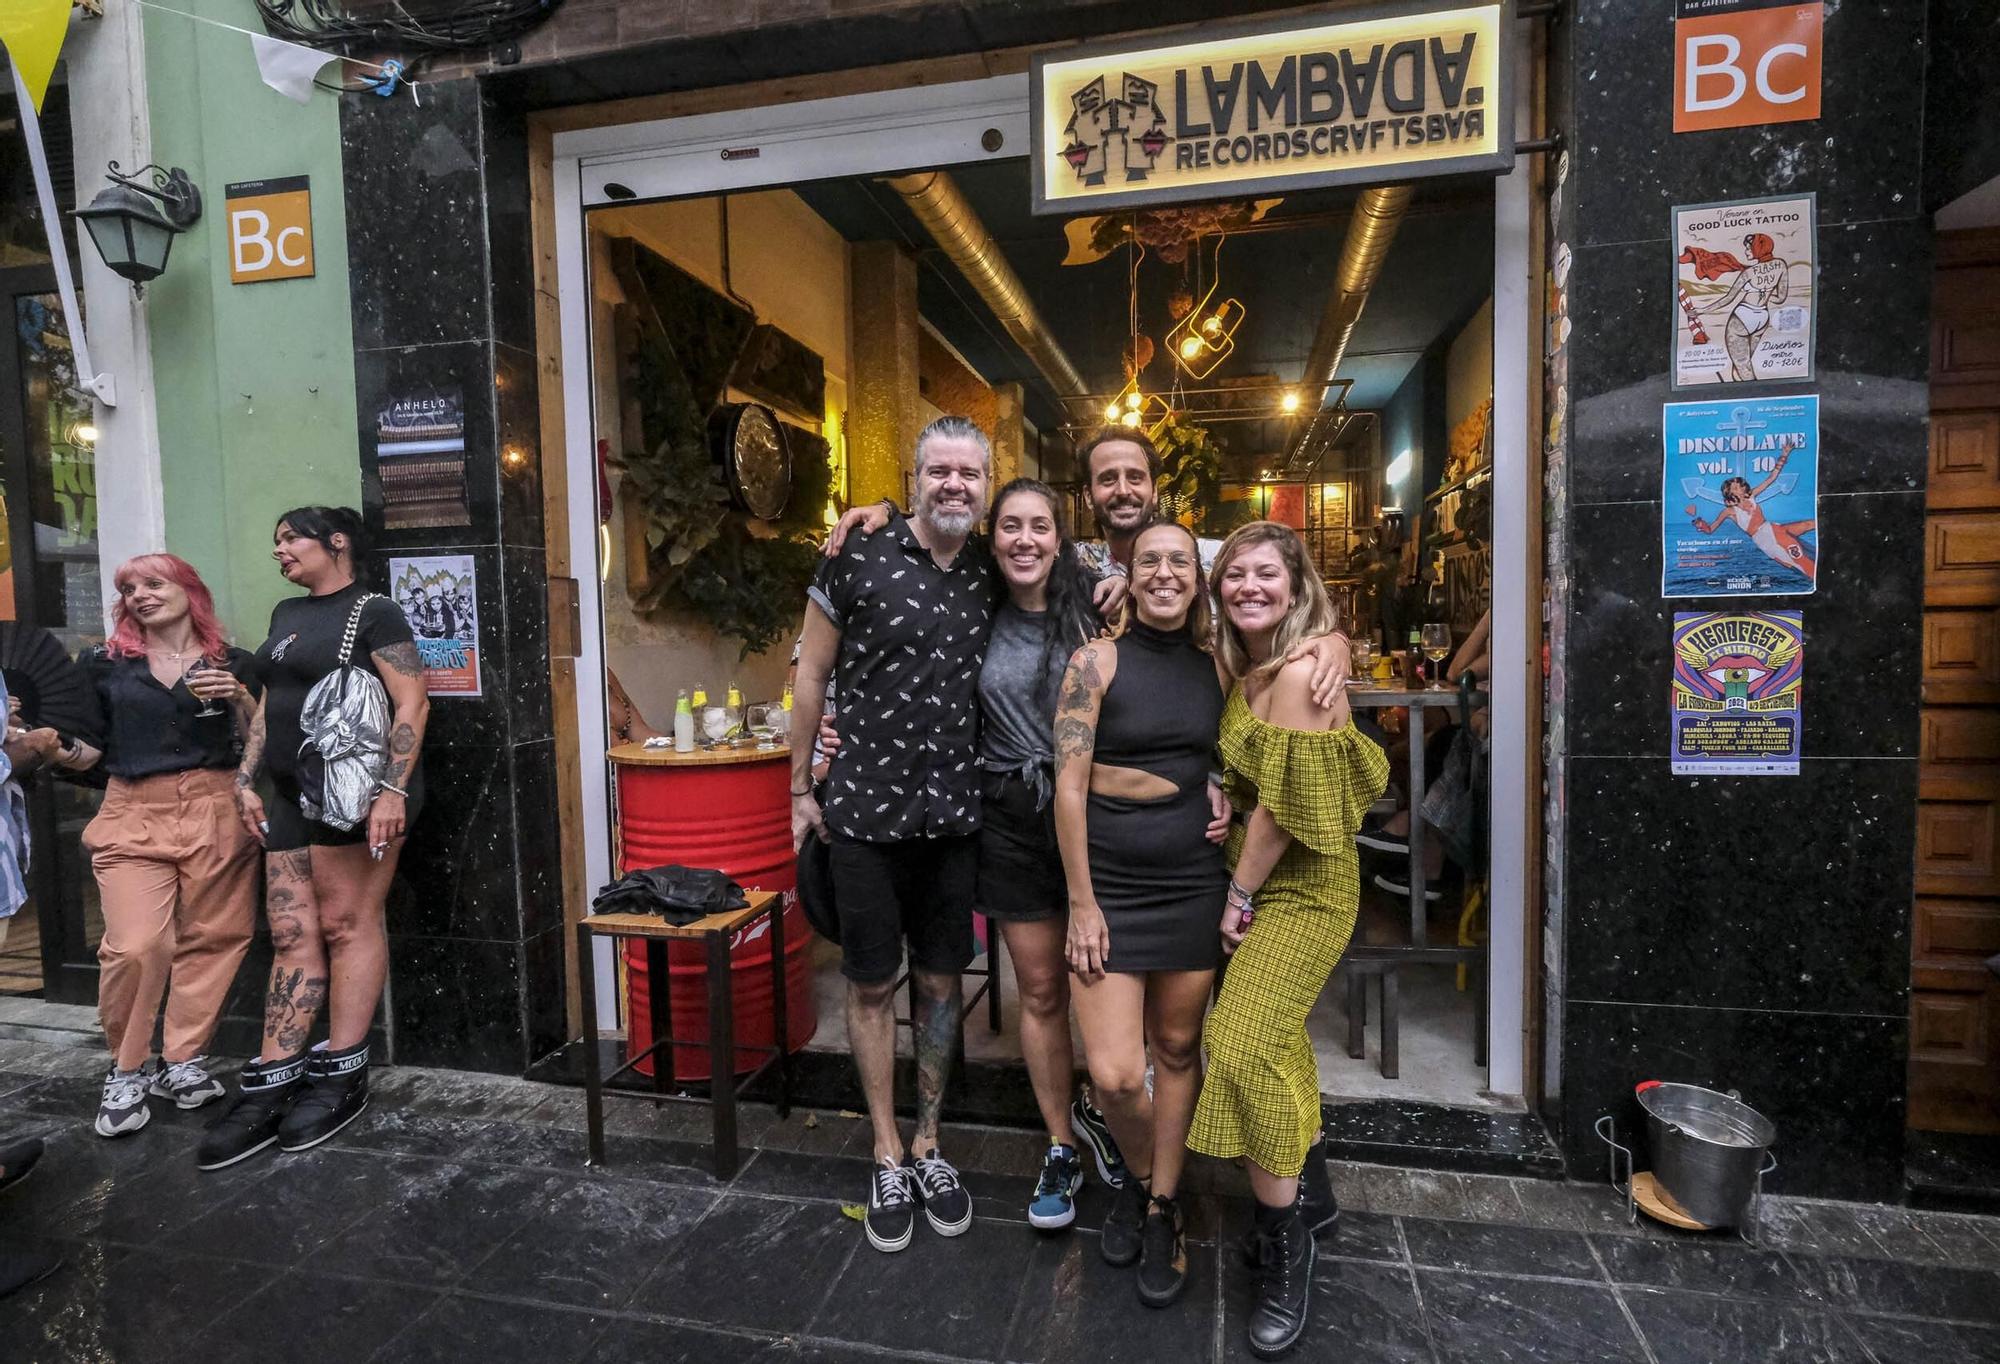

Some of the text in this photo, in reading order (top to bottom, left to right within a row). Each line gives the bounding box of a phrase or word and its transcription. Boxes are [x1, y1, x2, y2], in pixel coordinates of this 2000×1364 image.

[1685, 34, 1807, 112] Bc
[1688, 213, 1800, 232] GOOD LUCK TATTOO
[232, 209, 305, 272] Bc
[1752, 262, 1781, 275] FLASH
[1757, 274, 1775, 286] DAY
[1762, 359, 1774, 368] 80
[394, 399, 446, 411] ANHELO
[1678, 432, 1806, 455] DISCOLATE
[1697, 456, 1776, 475] vol. 10
[1687, 620, 1788, 654] HEROFEST
[1710, 644, 1766, 660] EL HIERRO
